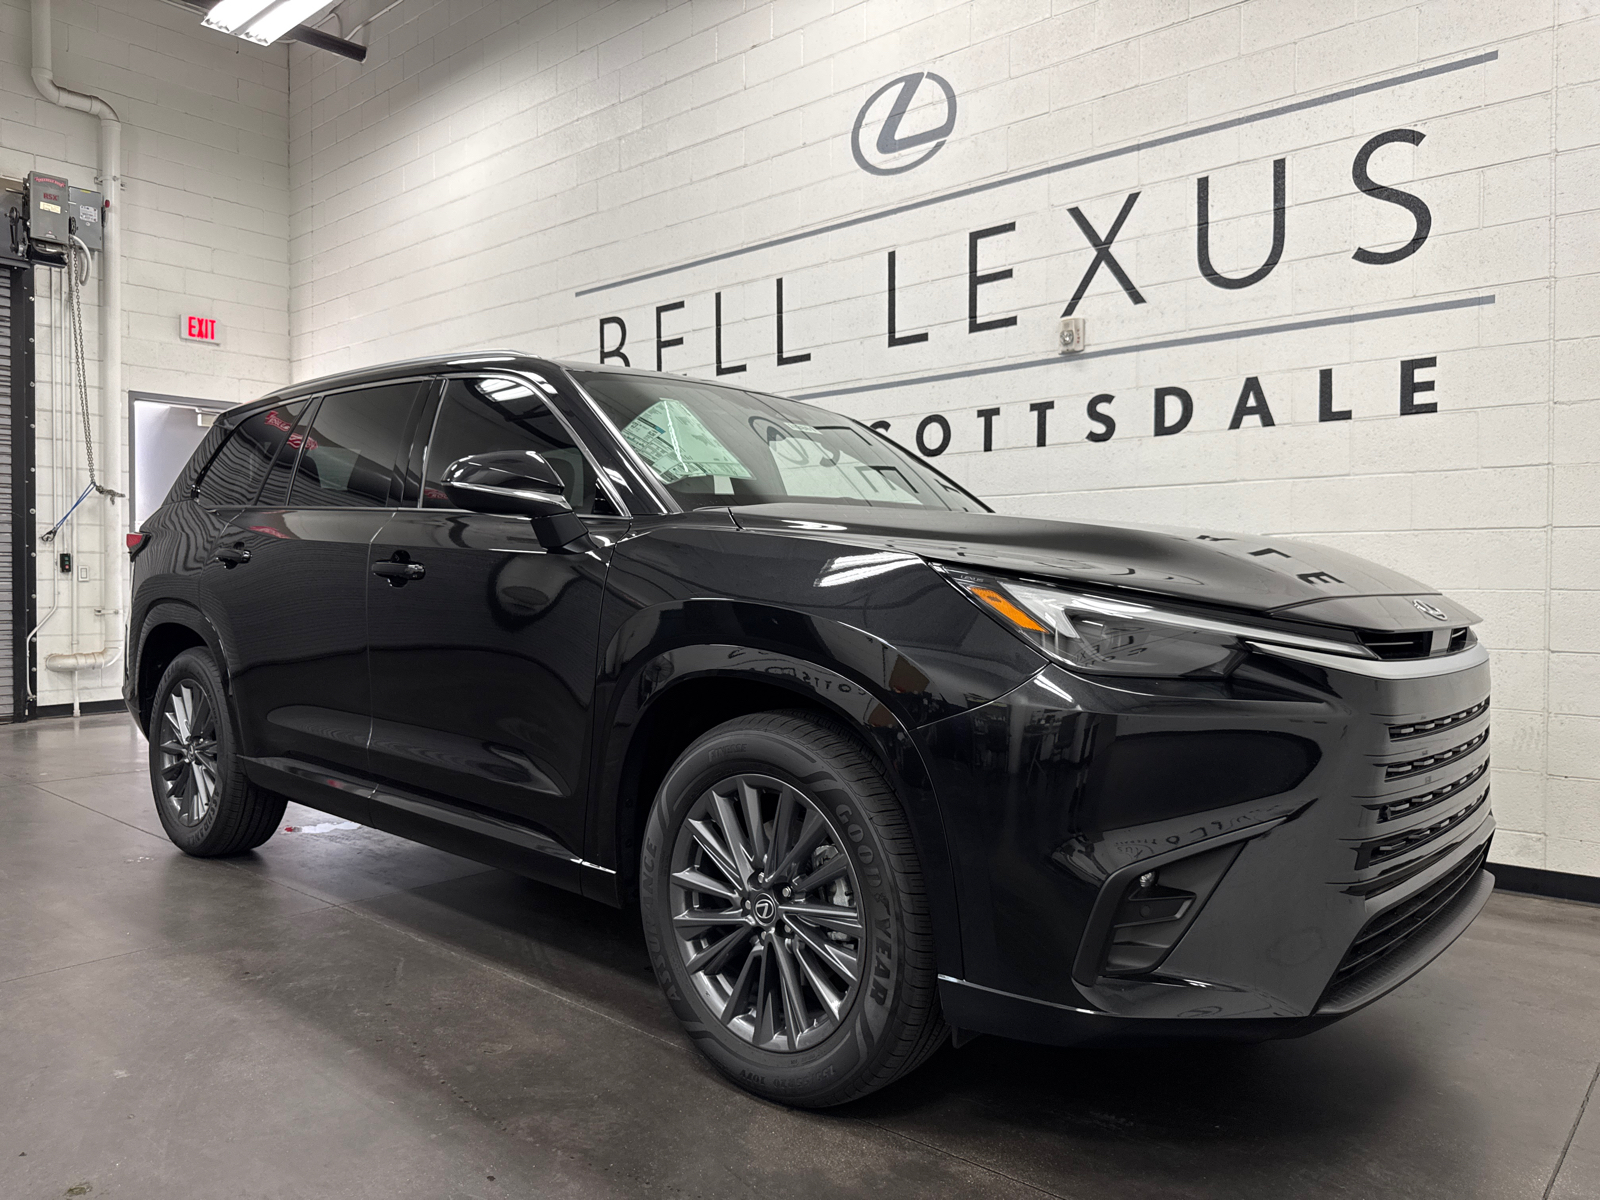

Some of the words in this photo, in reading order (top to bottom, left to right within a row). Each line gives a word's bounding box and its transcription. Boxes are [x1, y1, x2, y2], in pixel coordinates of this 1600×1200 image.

[43, 192, 58, 202] RSX
[599, 277, 812, 377] BELL
[887, 128, 1432, 348] LEXUS
[188, 315, 216, 340] EXIT
[869, 356, 1438, 458] OTTSDALE
[641, 837, 681, 1001] ASSURANCE
